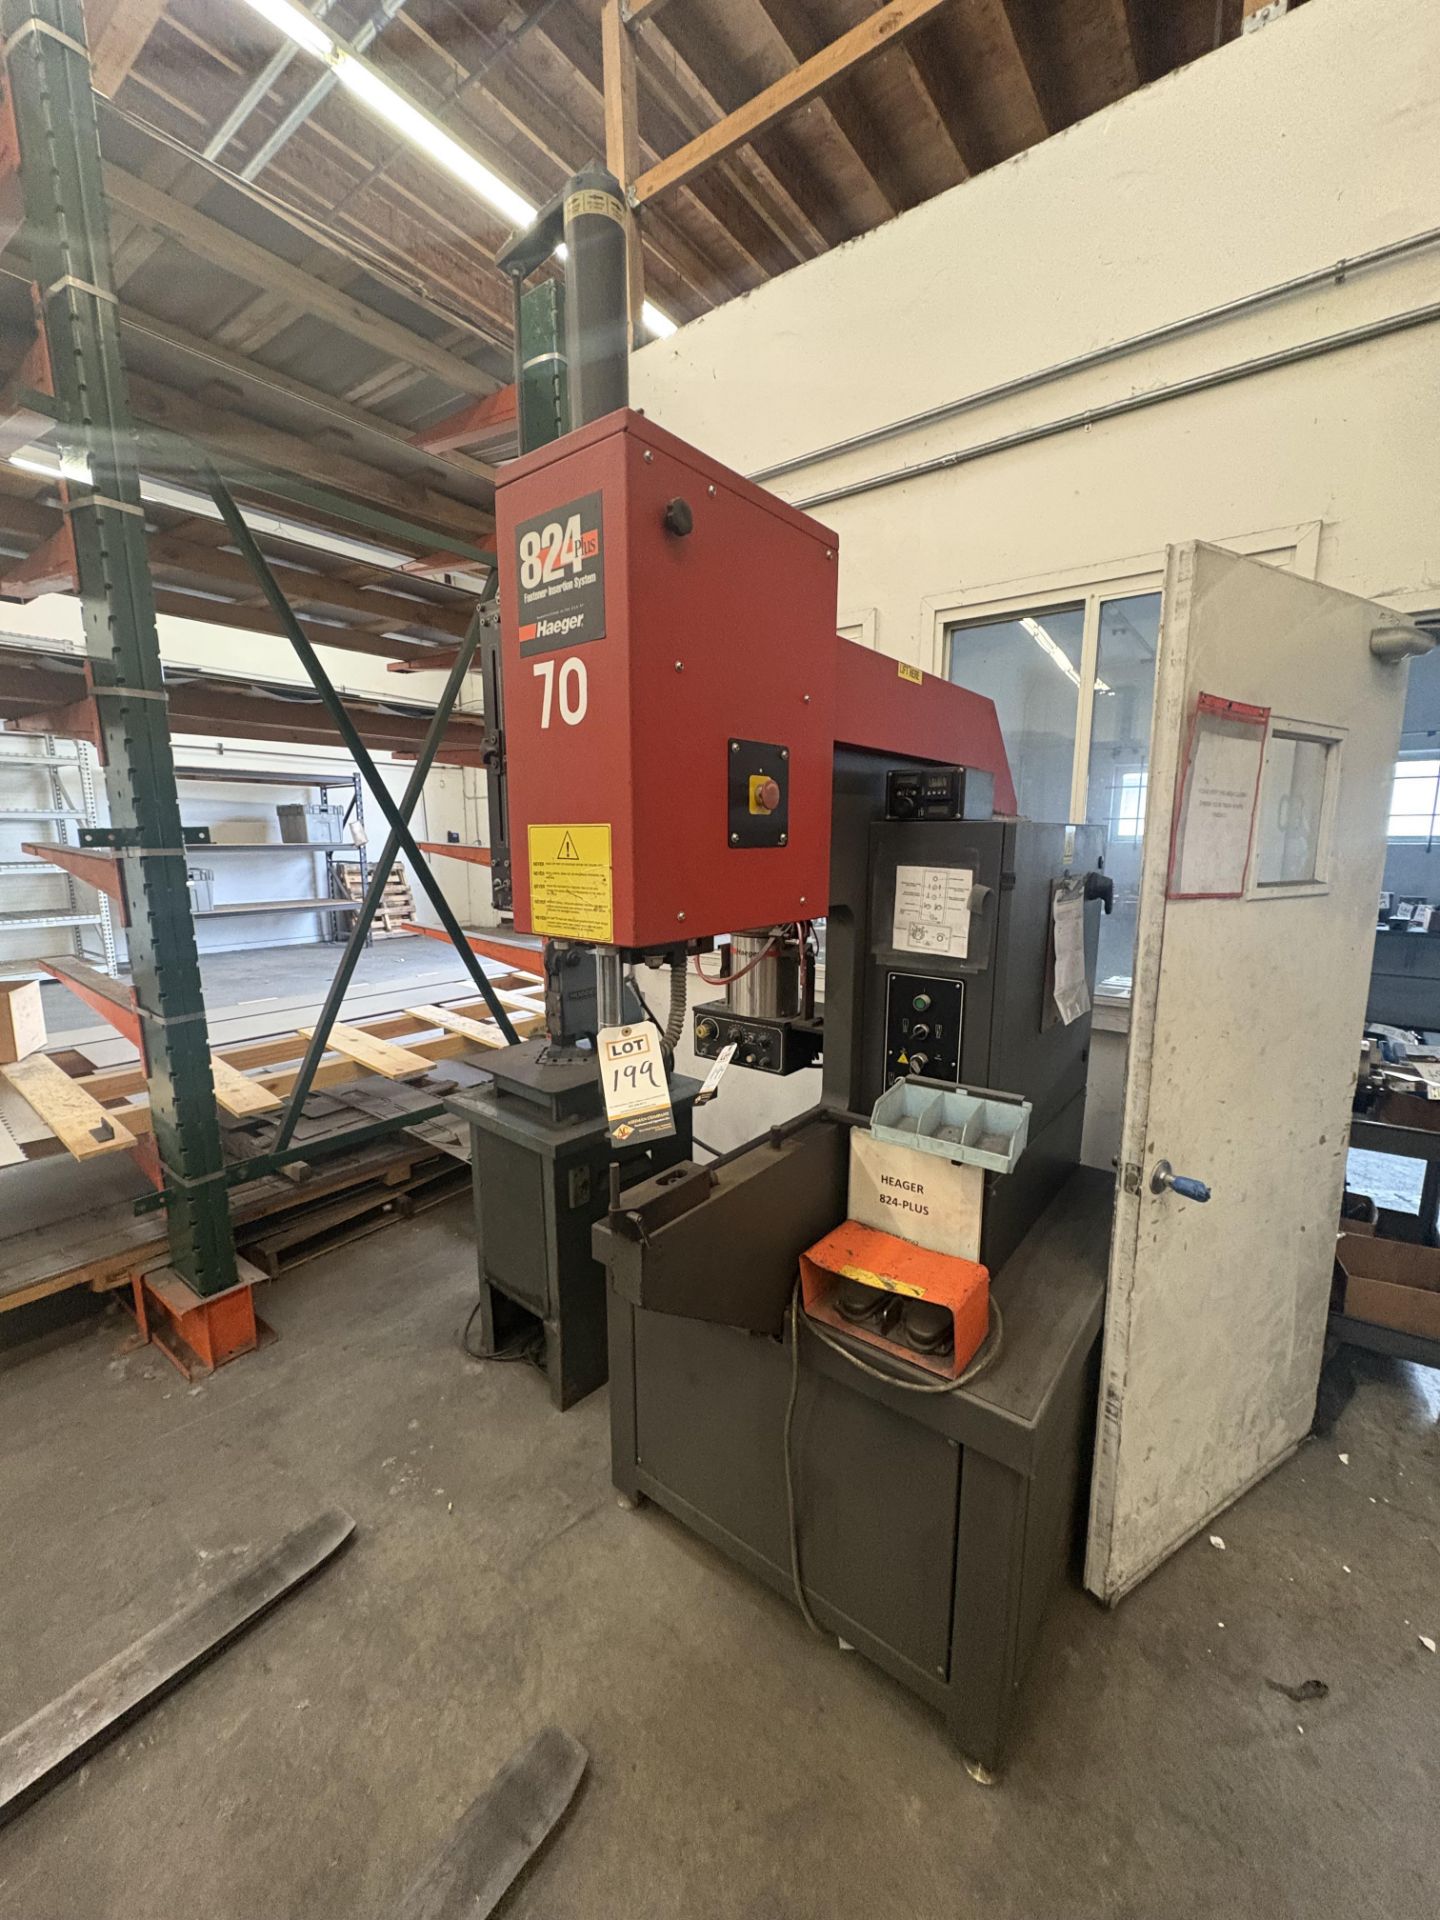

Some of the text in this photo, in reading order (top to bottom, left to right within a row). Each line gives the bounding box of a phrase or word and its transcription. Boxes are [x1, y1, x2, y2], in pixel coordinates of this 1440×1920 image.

[520, 513, 582, 589] 824
[575, 533, 596, 558] Plus
[524, 573, 597, 604] Fastener Insertion System
[536, 613, 584, 638] Haeger
[533, 657, 587, 729] 70
[611, 1038, 644, 1056] LOT
[613, 1060, 661, 1092] 199
[881, 1174, 925, 1194] HEAGER
[879, 1193, 930, 1216] 824-PLUS
